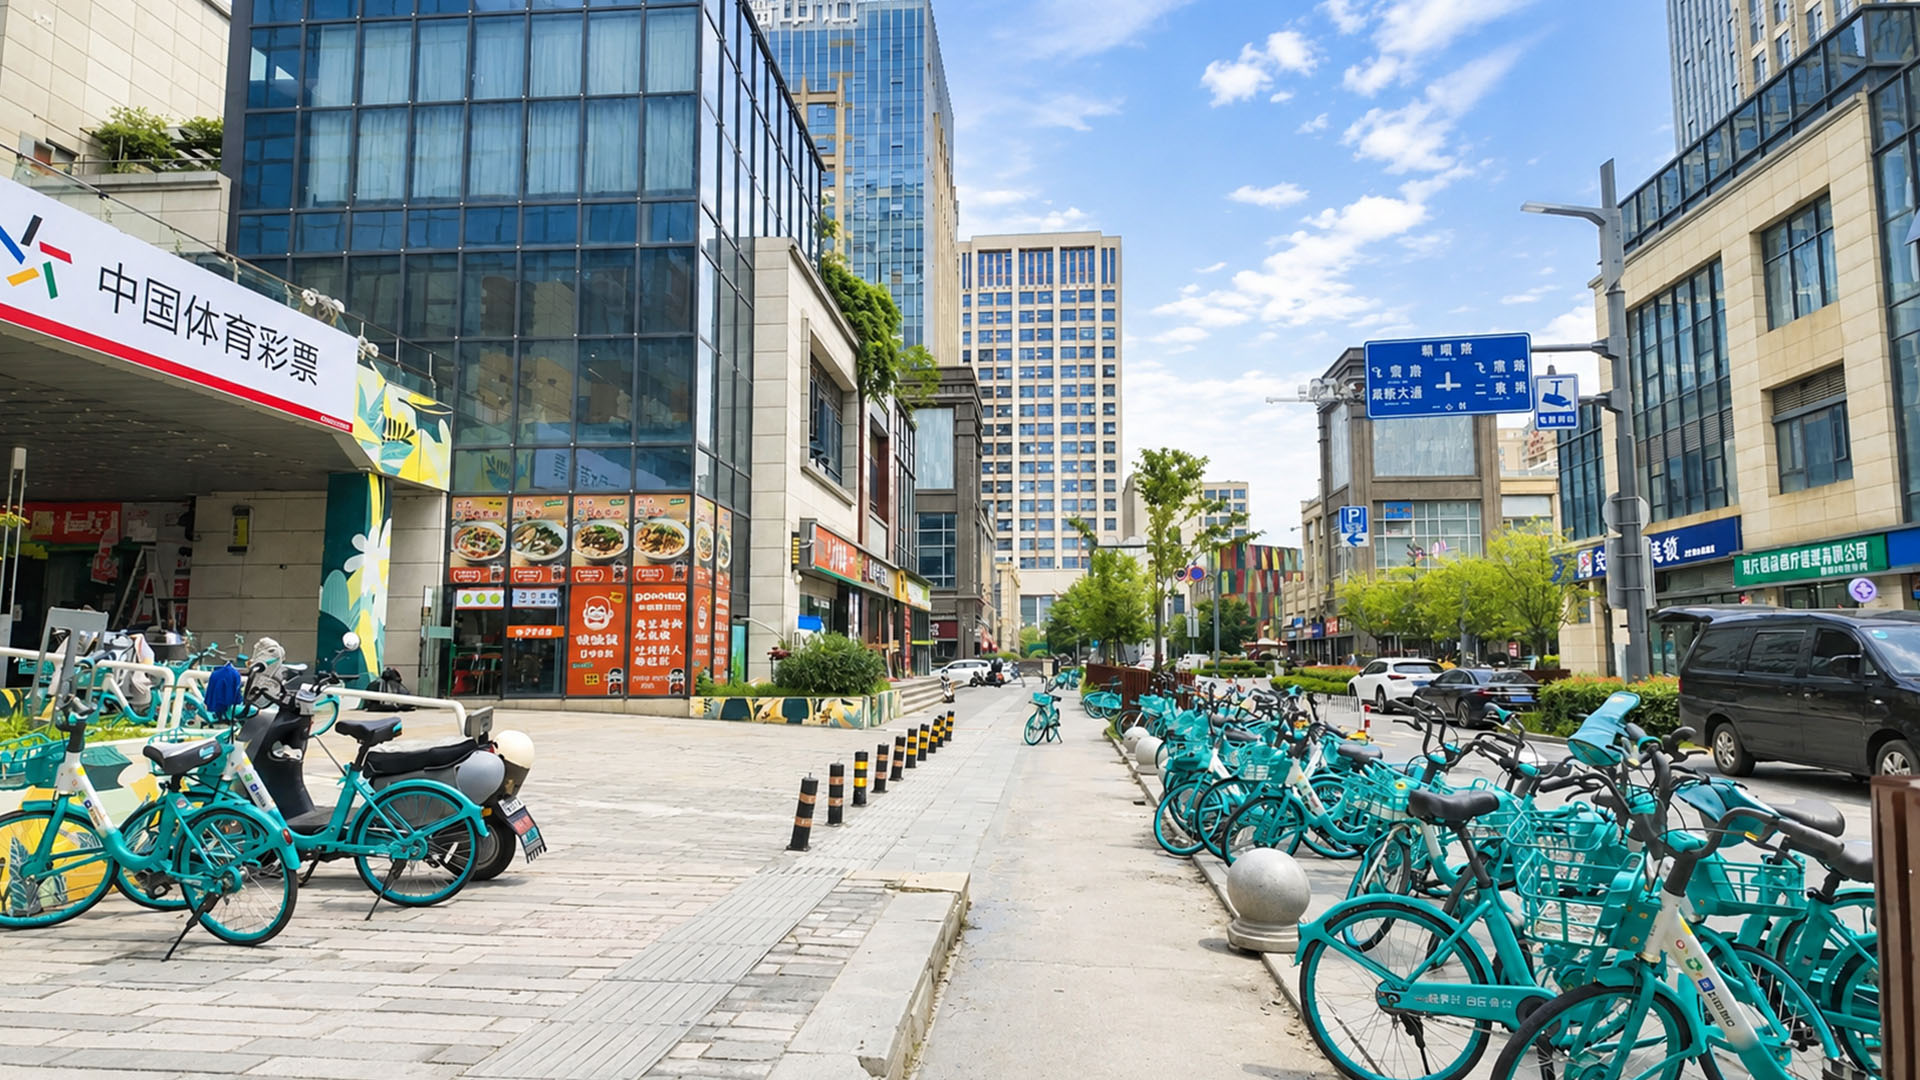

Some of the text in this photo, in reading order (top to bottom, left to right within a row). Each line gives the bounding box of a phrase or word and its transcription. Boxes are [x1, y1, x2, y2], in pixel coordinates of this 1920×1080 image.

[98, 262, 320, 387] 中国体育彩票
[1348, 508, 1360, 523] P
